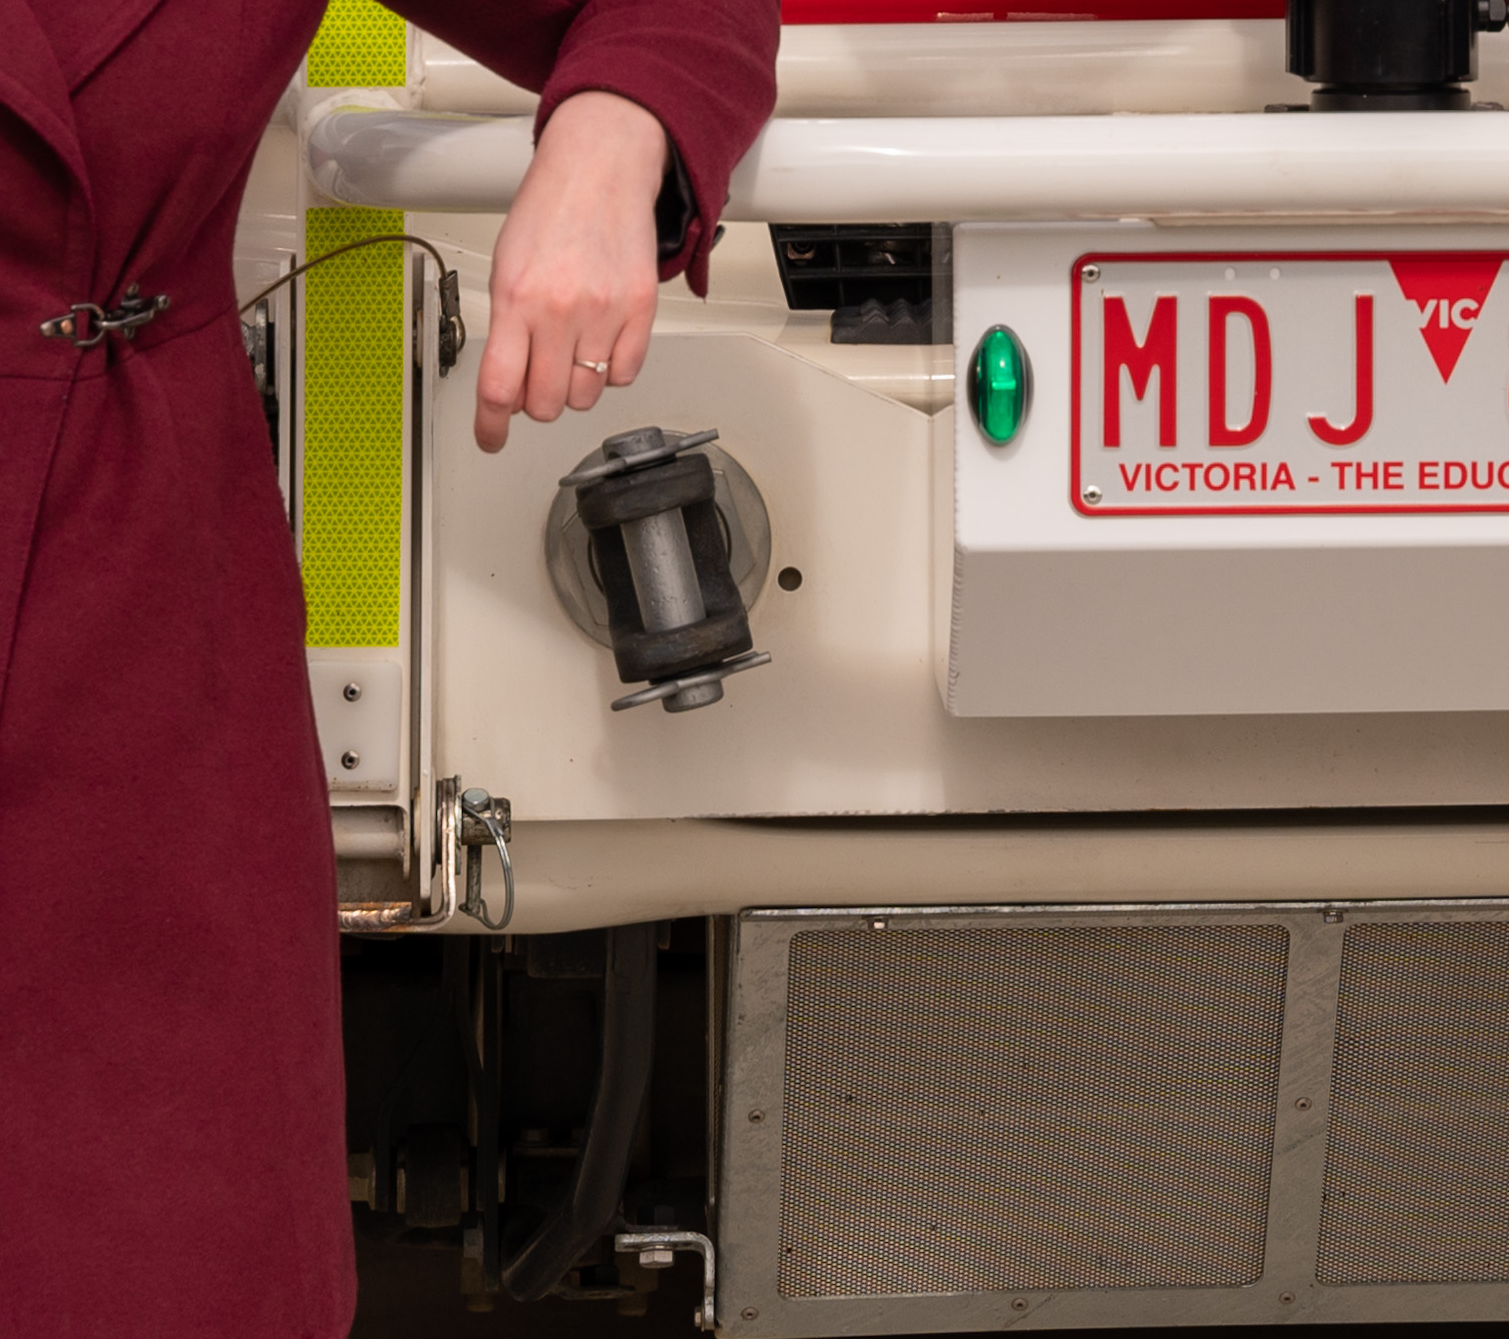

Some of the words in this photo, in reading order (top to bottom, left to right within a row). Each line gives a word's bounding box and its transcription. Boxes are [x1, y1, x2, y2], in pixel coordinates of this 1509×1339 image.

[1406, 298, 1479, 330] VIC
[1101, 293, 1375, 450] MDJ
[1118, 462, 1294, 492] VICTORIA
[1332, 462, 1405, 490] THE
